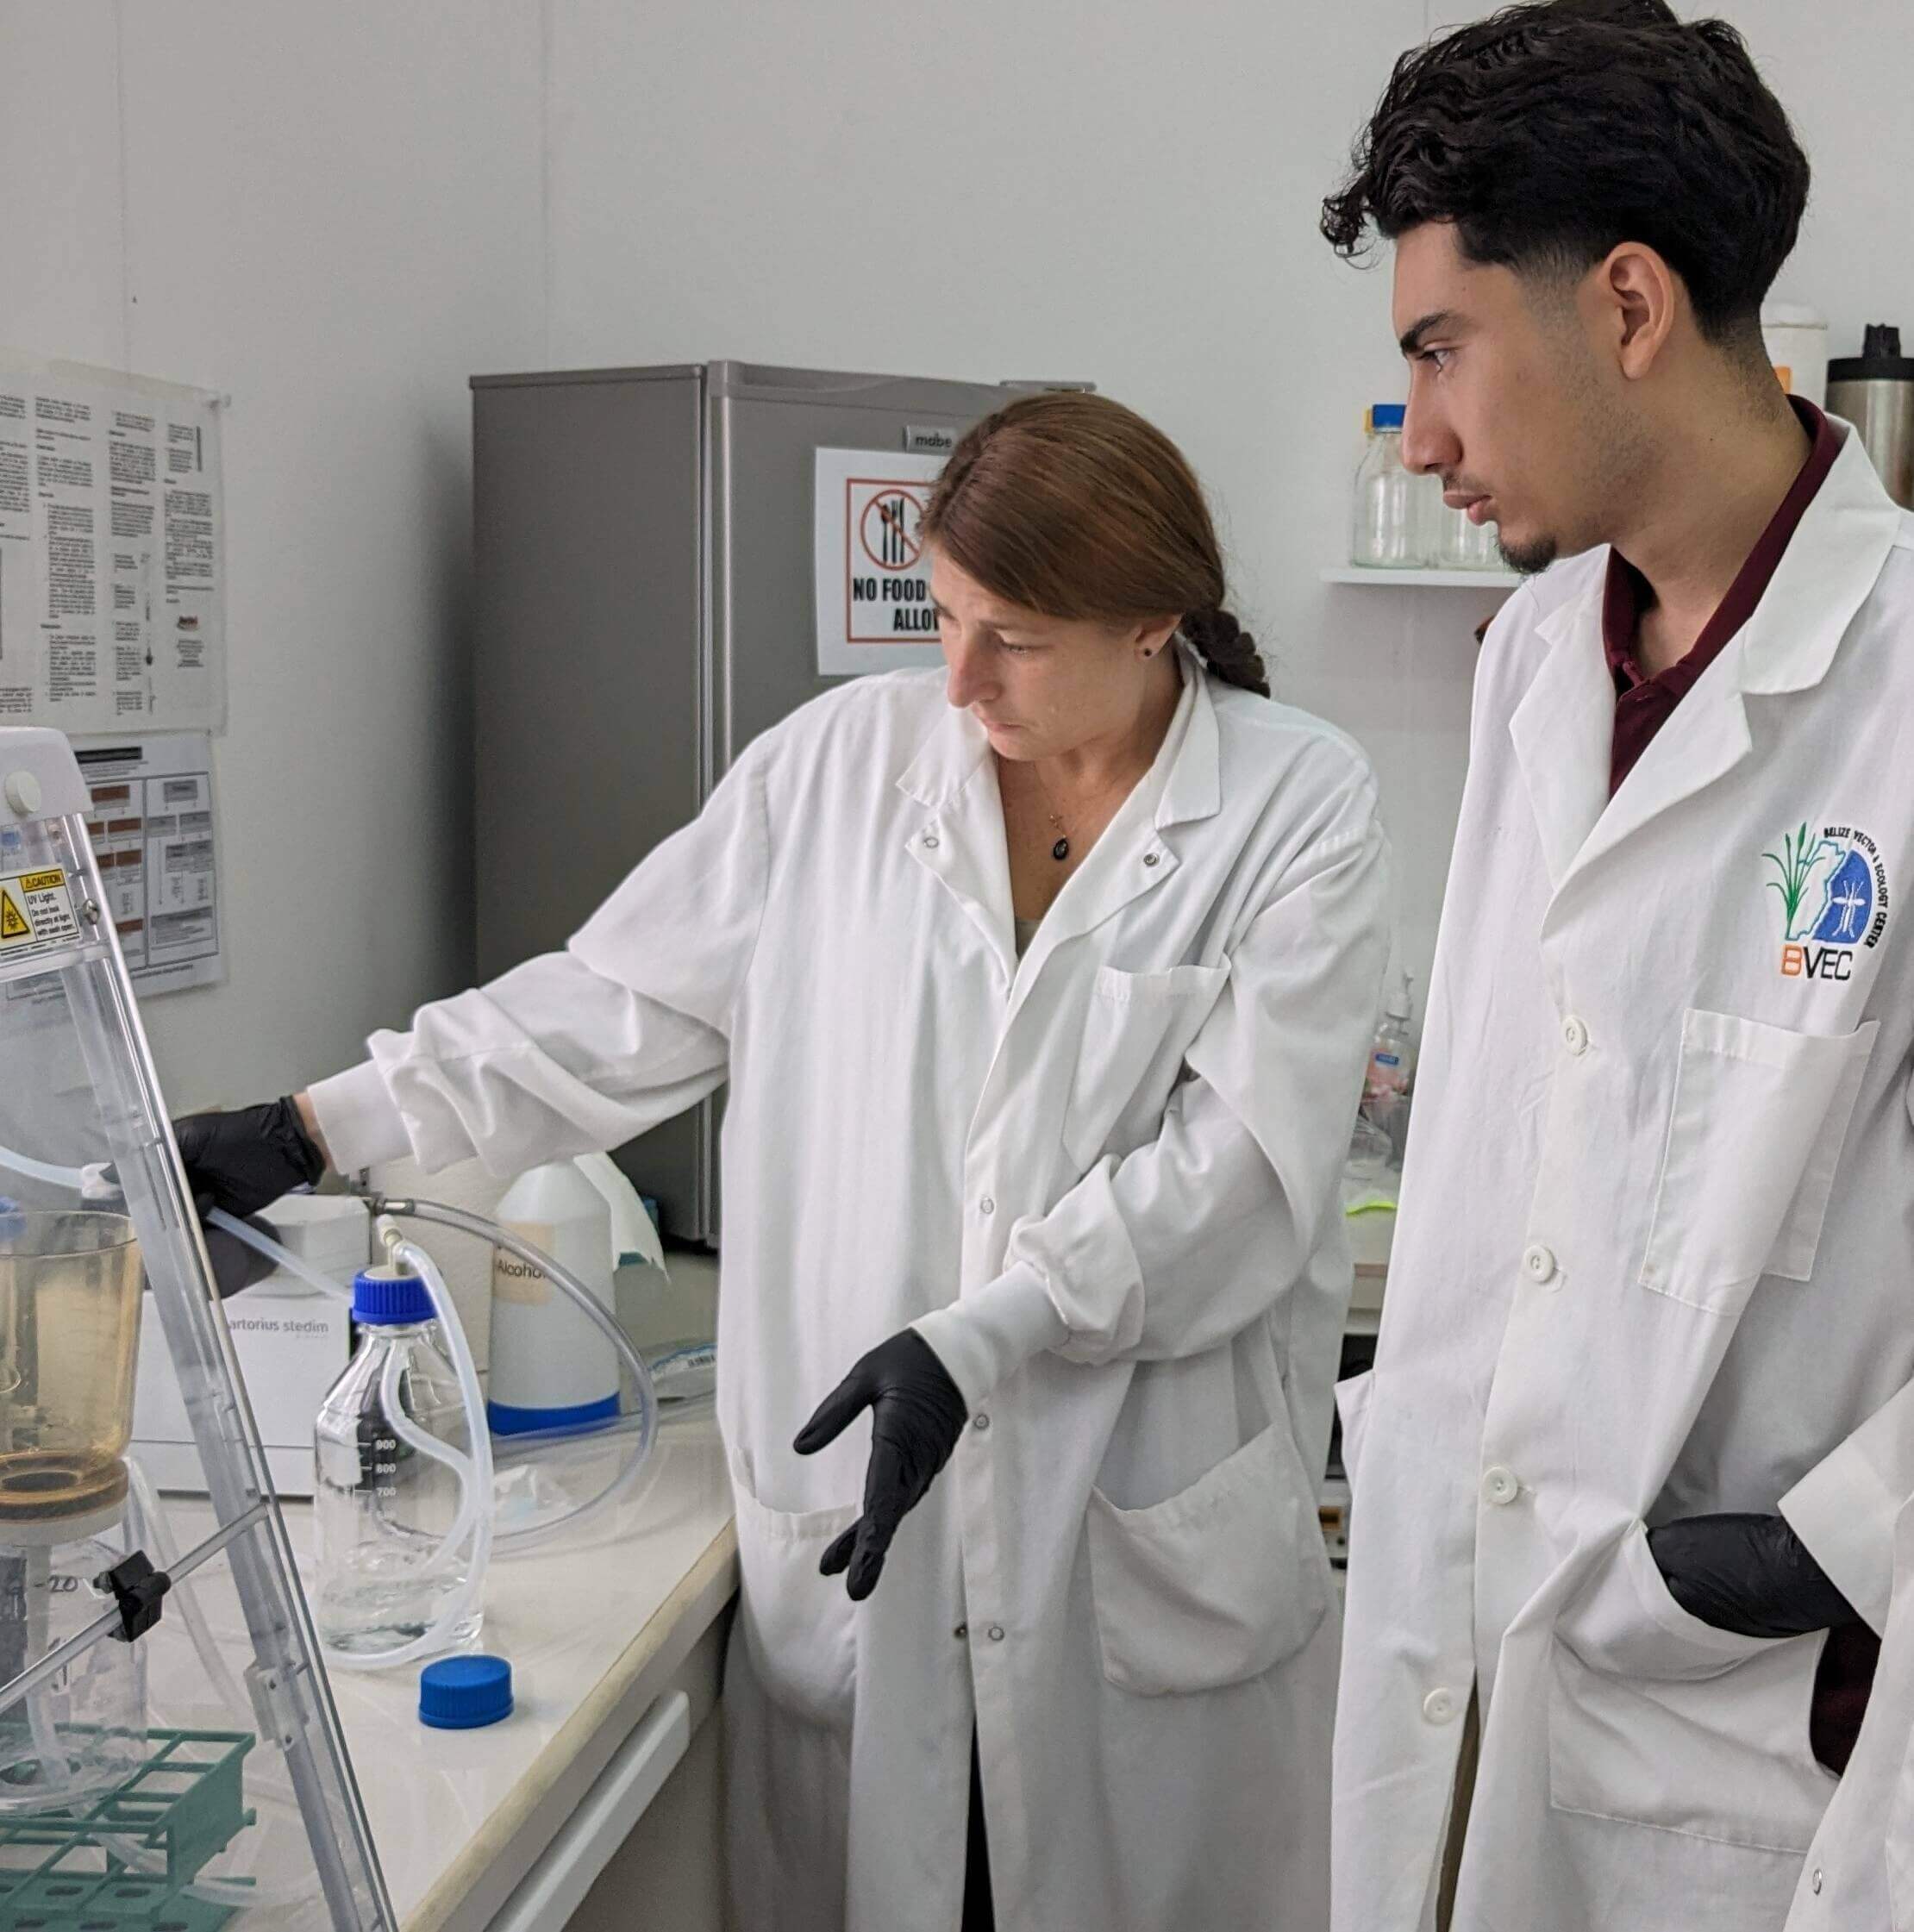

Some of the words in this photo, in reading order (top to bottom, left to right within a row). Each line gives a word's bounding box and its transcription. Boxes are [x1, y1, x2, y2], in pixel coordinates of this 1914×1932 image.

[915, 431, 953, 447] mabe
[853, 578, 878, 602] NO
[882, 578, 927, 602] FOOD
[1823, 827, 1851, 839] BELIZE
[1854, 829, 1877, 855] VECTOR
[32, 874, 61, 888] CAUTION
[1874, 863, 1888, 909] ECOLOGY
[28, 895, 37, 905] UV
[1863, 911, 1888, 948] CENTER
[1780, 943, 1854, 981] BVEC
[496, 1259, 546, 1279] Alcoho
[229, 1317, 279, 1331] artorius
[283, 1319, 329, 1333] stedim
[375, 1439, 397, 1451] 900
[375, 1463, 397, 1475] 800
[375, 1486, 397, 1497] 700
